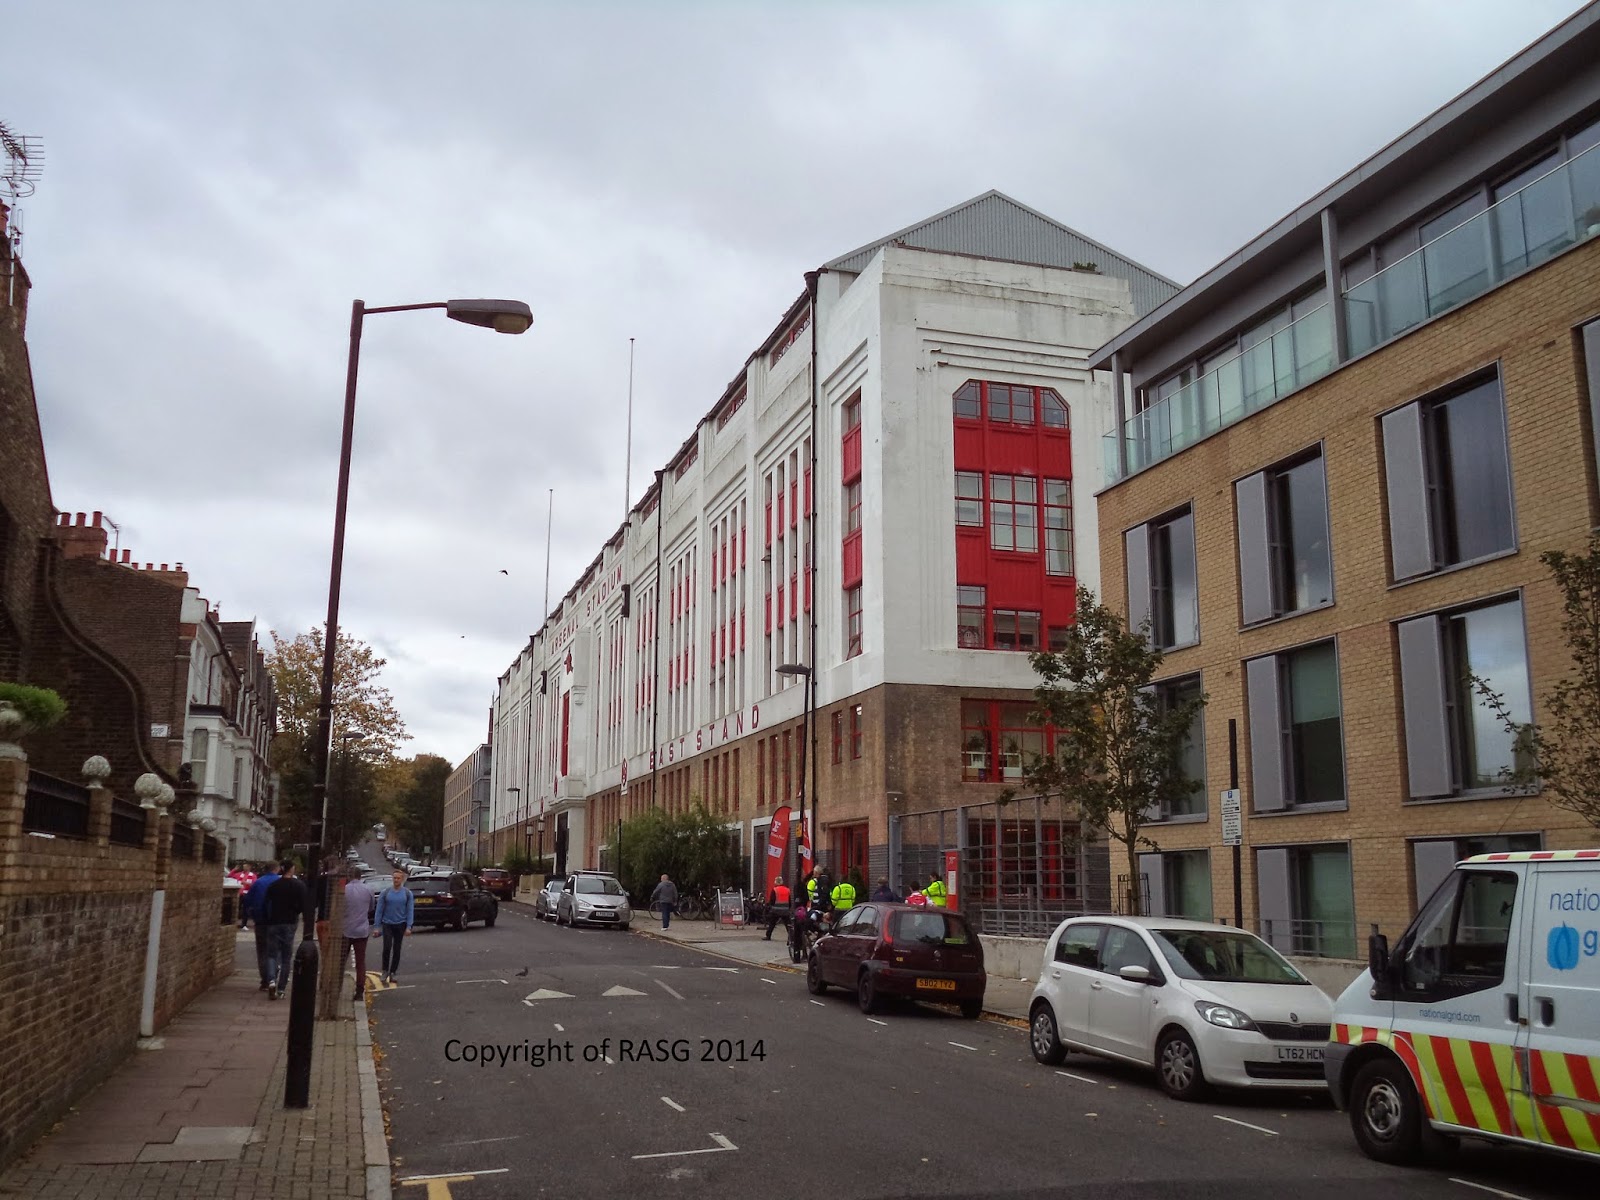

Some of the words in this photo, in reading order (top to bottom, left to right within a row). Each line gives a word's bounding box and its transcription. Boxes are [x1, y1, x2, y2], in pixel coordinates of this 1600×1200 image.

[551, 614, 579, 656] ARSENAL
[587, 564, 622, 617] STADIUM
[649, 737, 685, 770] EAST
[696, 704, 759, 751] STAND
[1549, 887, 1600, 911] natio
[1583, 930, 1598, 956] g
[1419, 1008, 1481, 1023] nationalgrid.com
[1278, 1048, 1305, 1060] LT62
[1306, 1049, 1325, 1060] HCN
